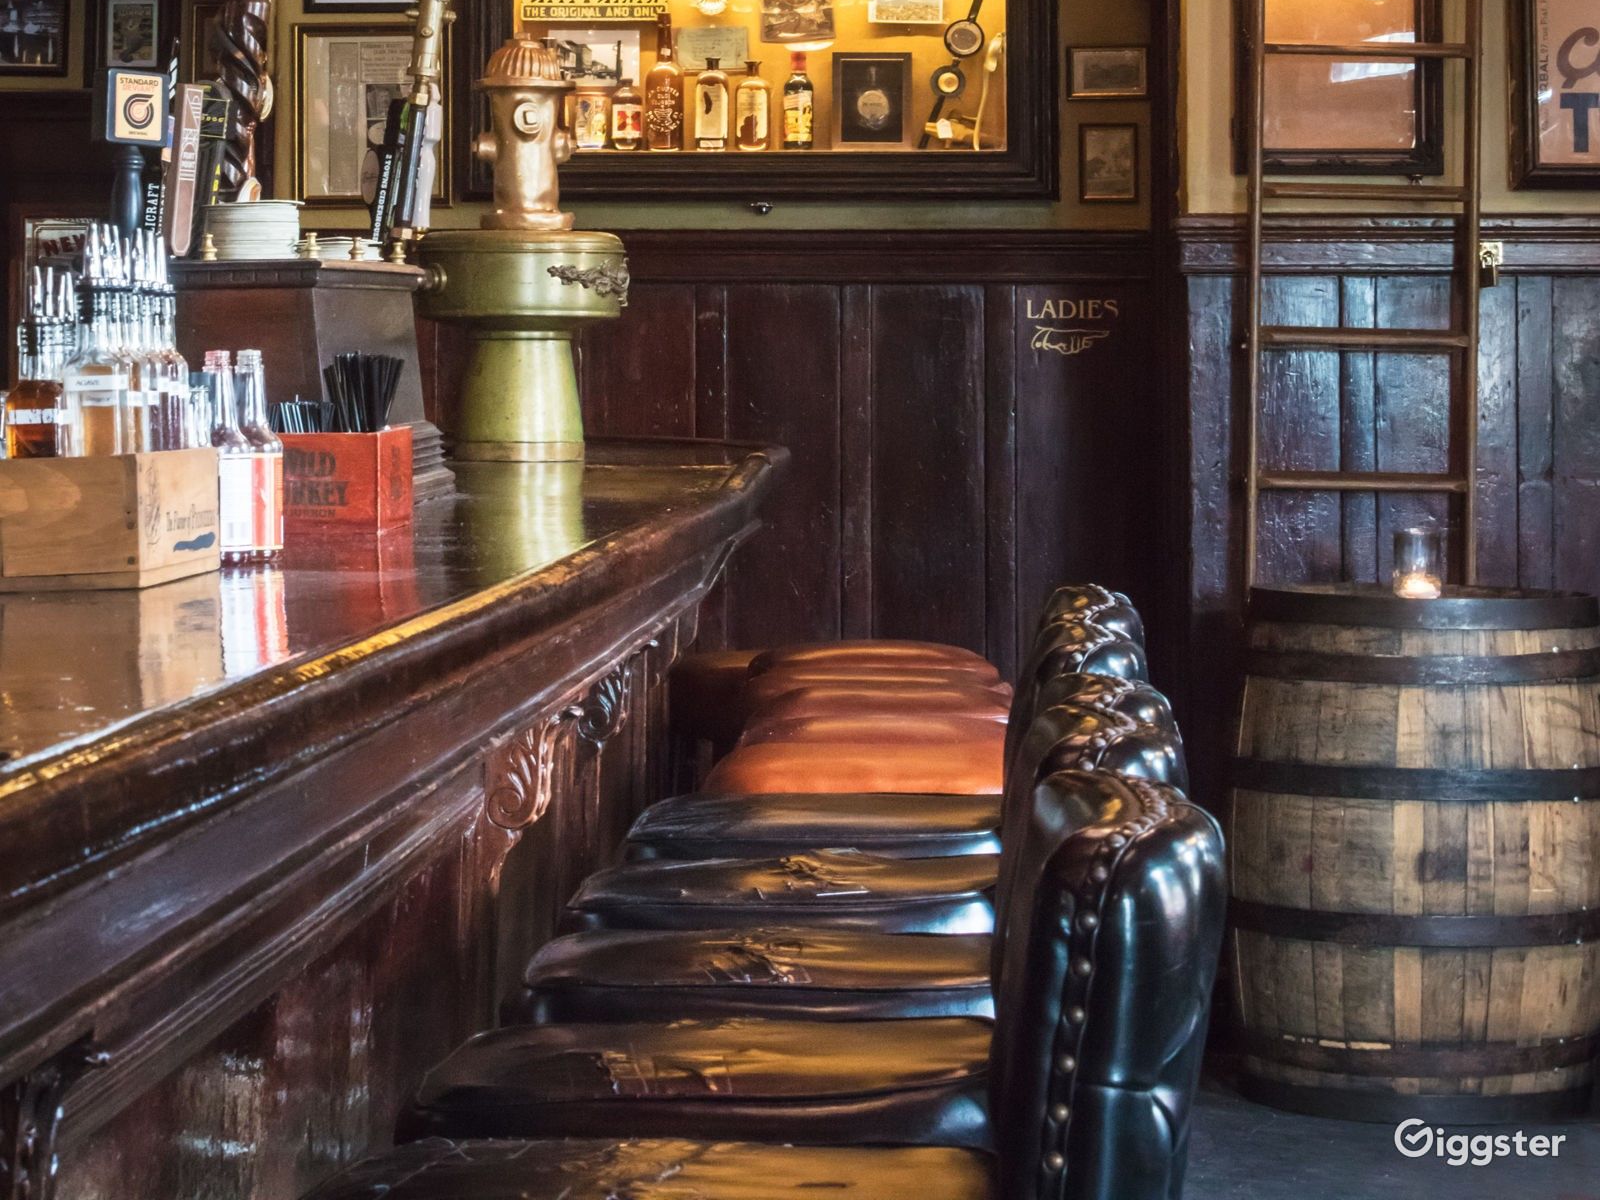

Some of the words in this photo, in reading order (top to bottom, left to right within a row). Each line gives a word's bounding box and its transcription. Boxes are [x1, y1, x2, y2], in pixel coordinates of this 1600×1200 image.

[525, 6, 546, 17] THE
[550, 6, 601, 17] ORIGINAL
[606, 6, 630, 17] AND
[634, 6, 664, 17] ONLY
[120, 77, 159, 86] STANDARD
[381, 160, 392, 189] TOWNS
[1026, 299, 1119, 319] LADIES
